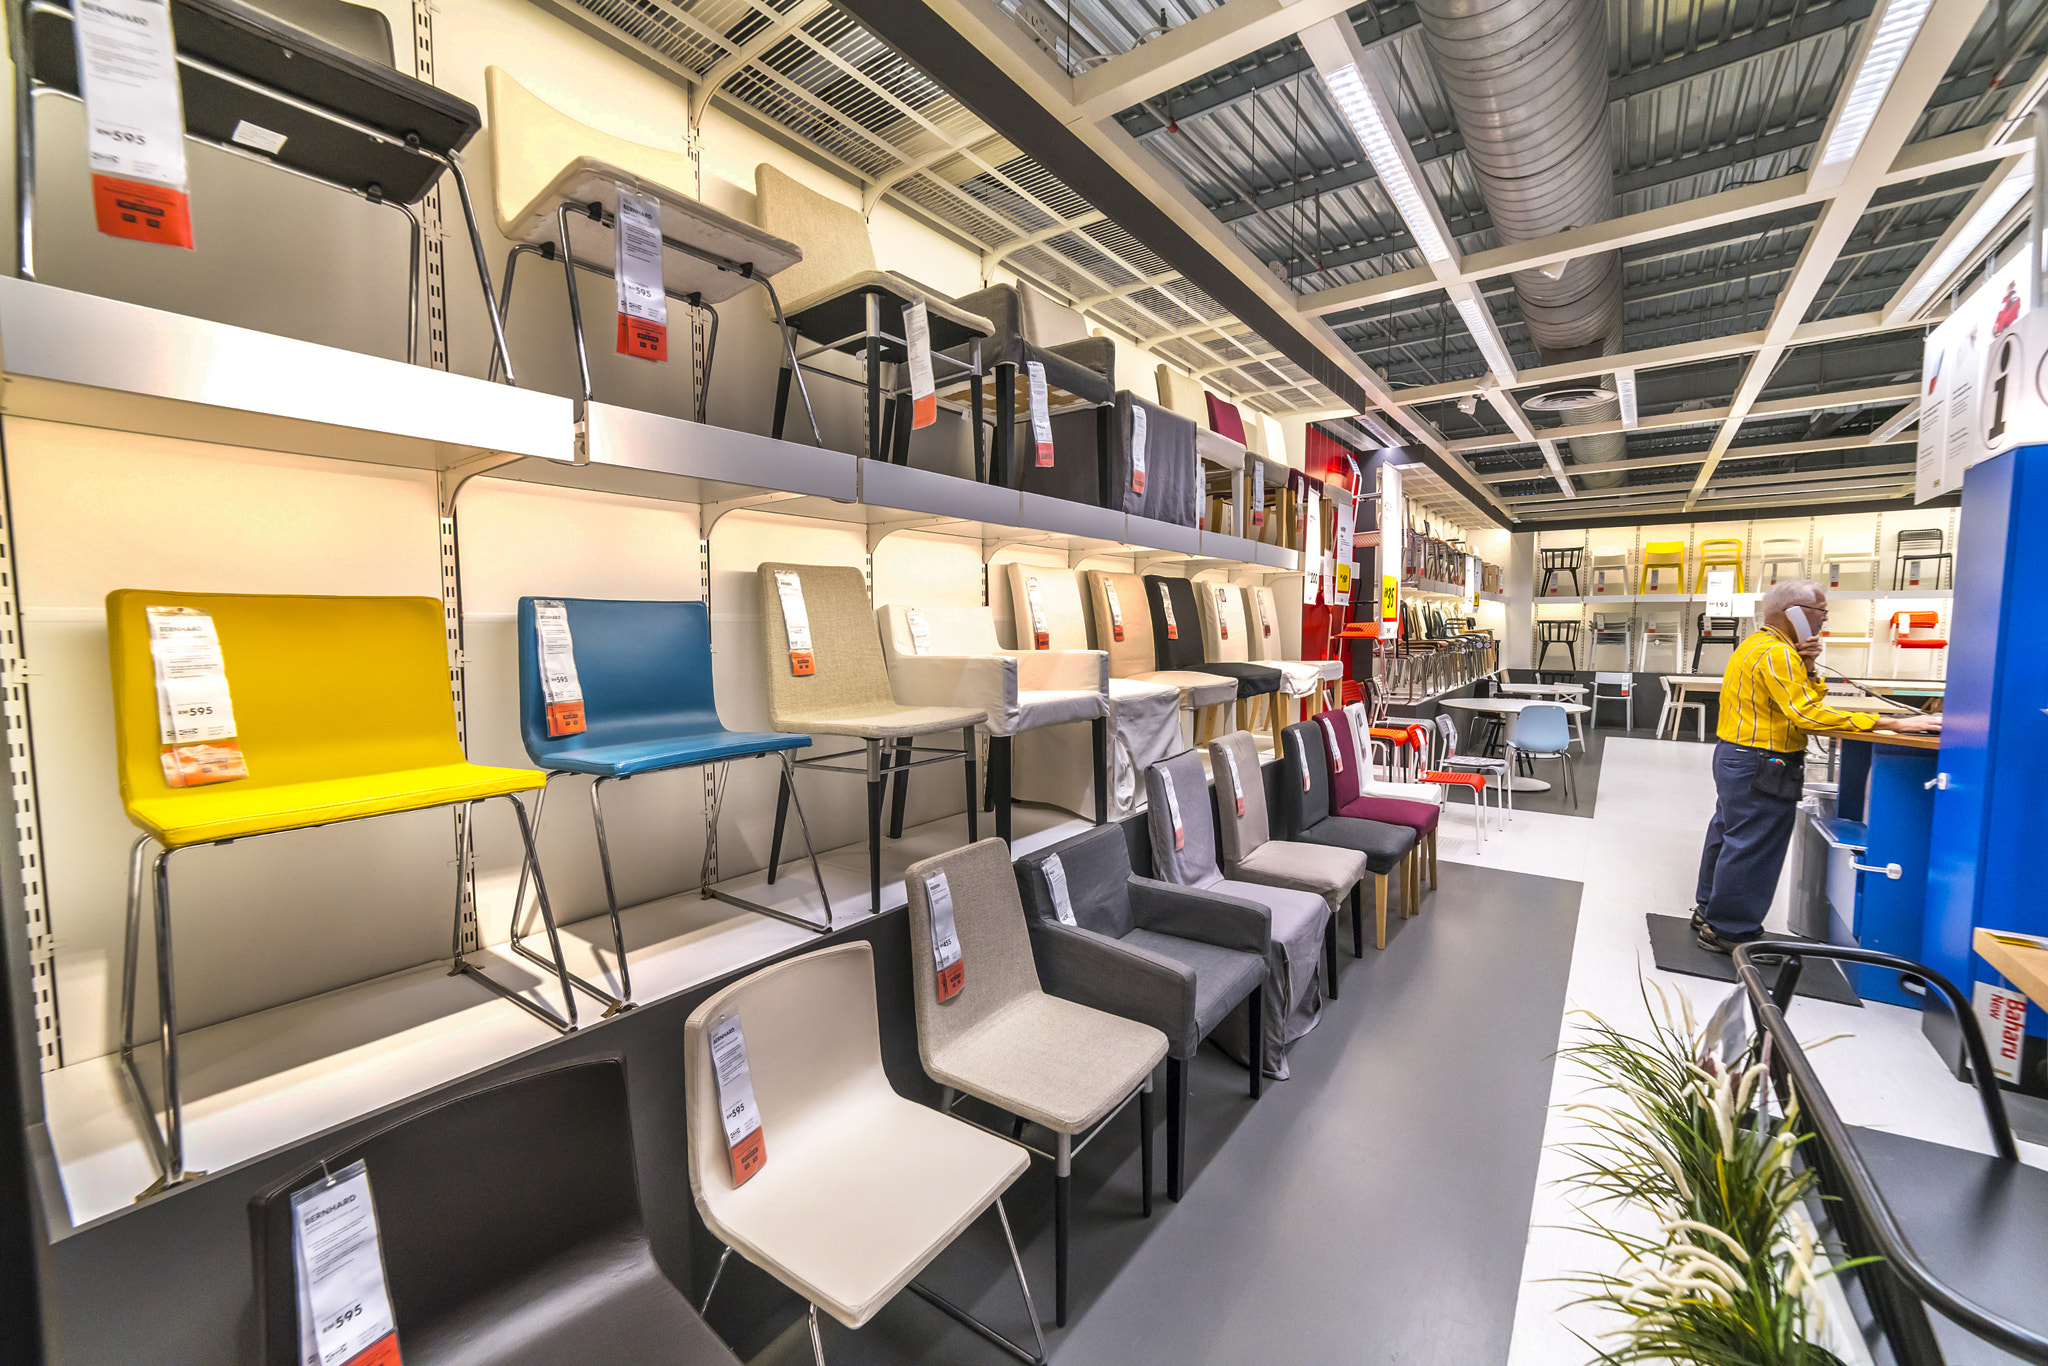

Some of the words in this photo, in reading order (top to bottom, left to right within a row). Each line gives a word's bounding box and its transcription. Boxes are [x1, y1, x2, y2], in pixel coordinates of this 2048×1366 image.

[623, 203, 653, 220] BERNHARD
[1988, 993, 2006, 1020] New
[712, 1027, 736, 1045] BERNHARD
[2000, 998, 2027, 1061] Baharu
[304, 1193, 357, 1227] BERNHARD
